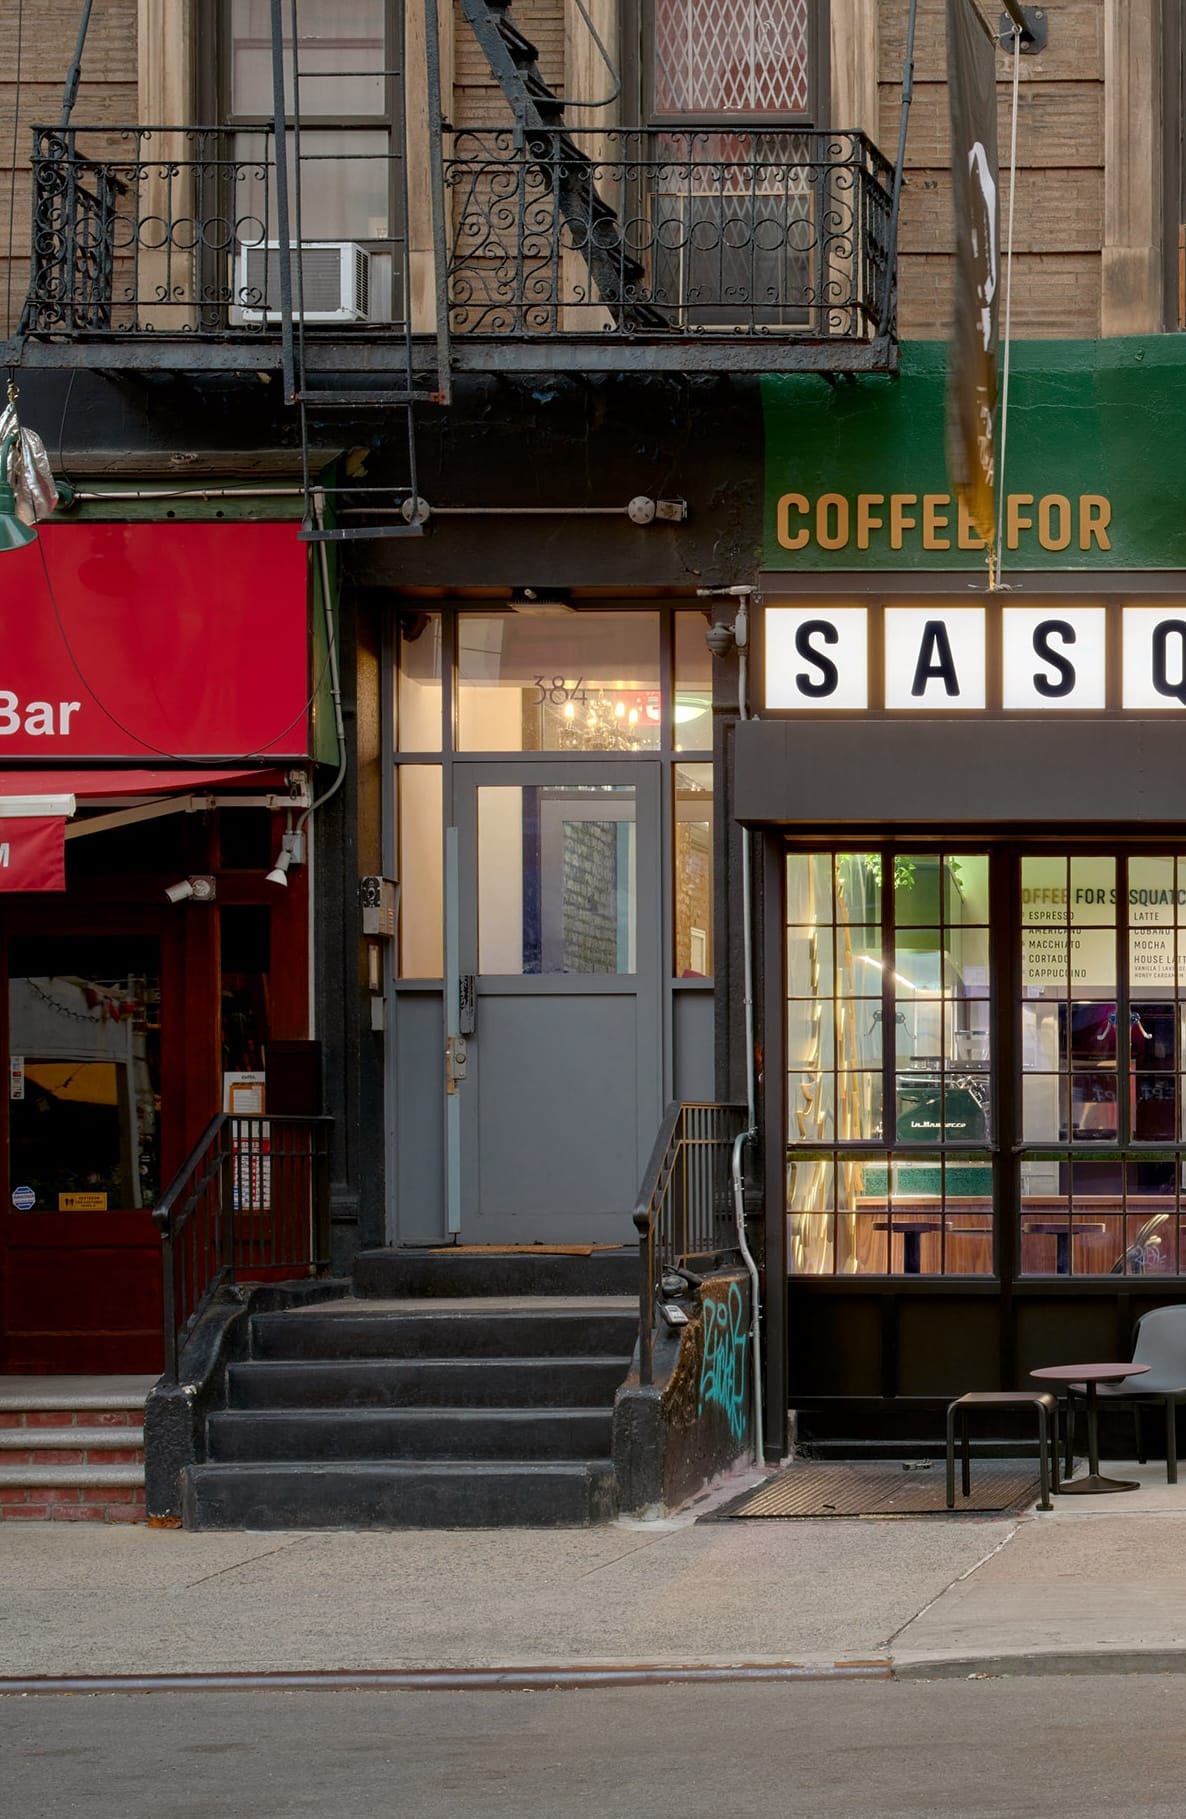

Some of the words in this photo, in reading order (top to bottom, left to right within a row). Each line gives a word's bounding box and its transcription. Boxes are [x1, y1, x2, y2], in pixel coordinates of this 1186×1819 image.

[777, 493, 987, 550] COFFEE
[1006, 493, 1112, 550] FOR
[532, 675, 588, 706] 384
[0, 690, 81, 736] Bar
[1022, 887, 1068, 905] OFFEE
[1075, 888, 1106, 905] FOR
[1133, 911, 1160, 921] LATTE
[1133, 940, 1166, 950] MOCHA
[1133, 954, 1164, 964] HOUSE
